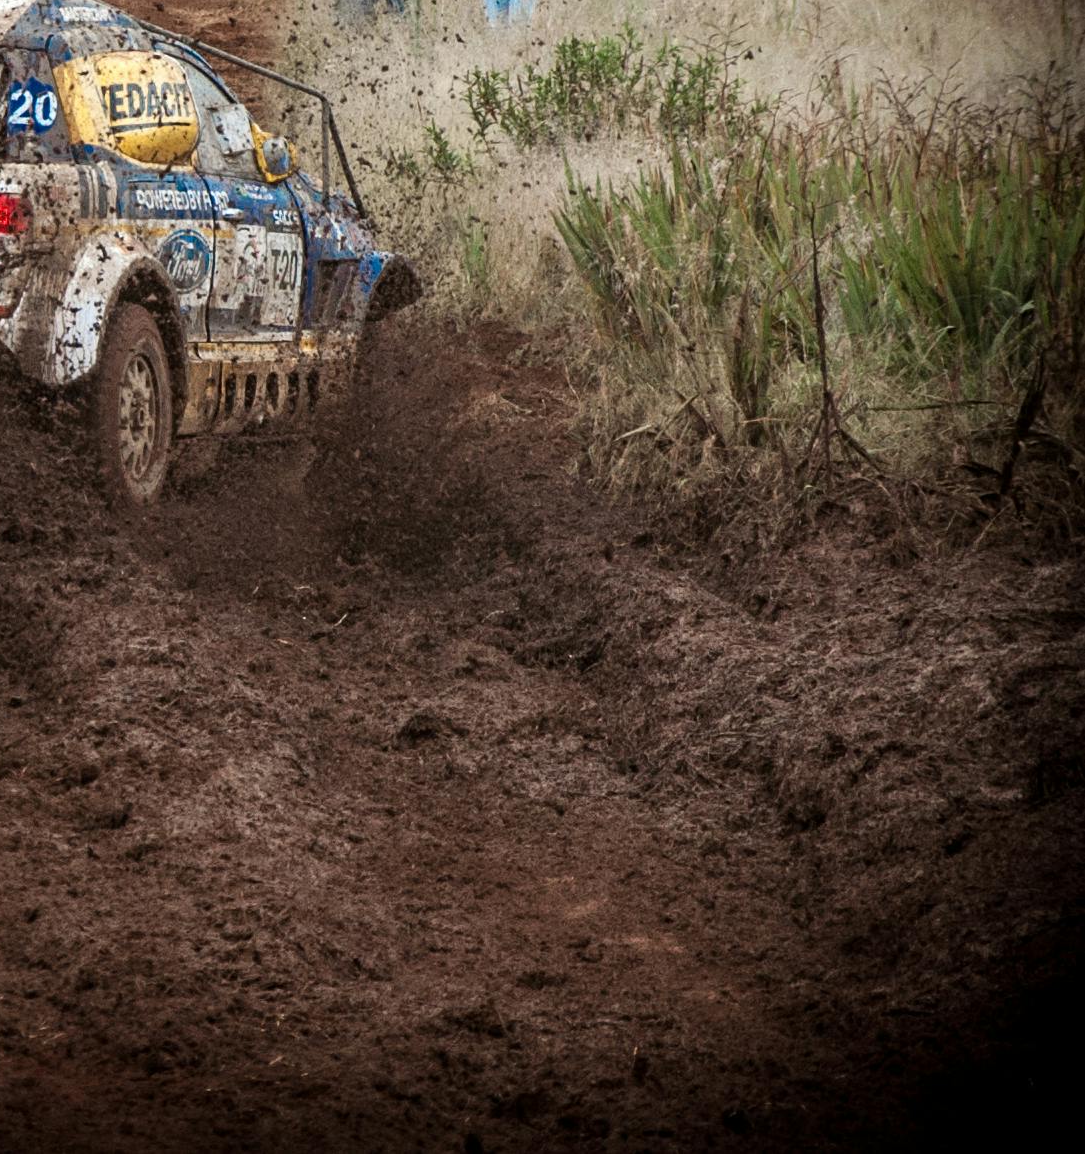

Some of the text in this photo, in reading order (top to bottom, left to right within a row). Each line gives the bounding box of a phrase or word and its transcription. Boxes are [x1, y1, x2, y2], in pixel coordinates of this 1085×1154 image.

[7, 88, 58, 127] 20
[135, 189, 189, 211] POWERED
[187, 189, 203, 211] BY
